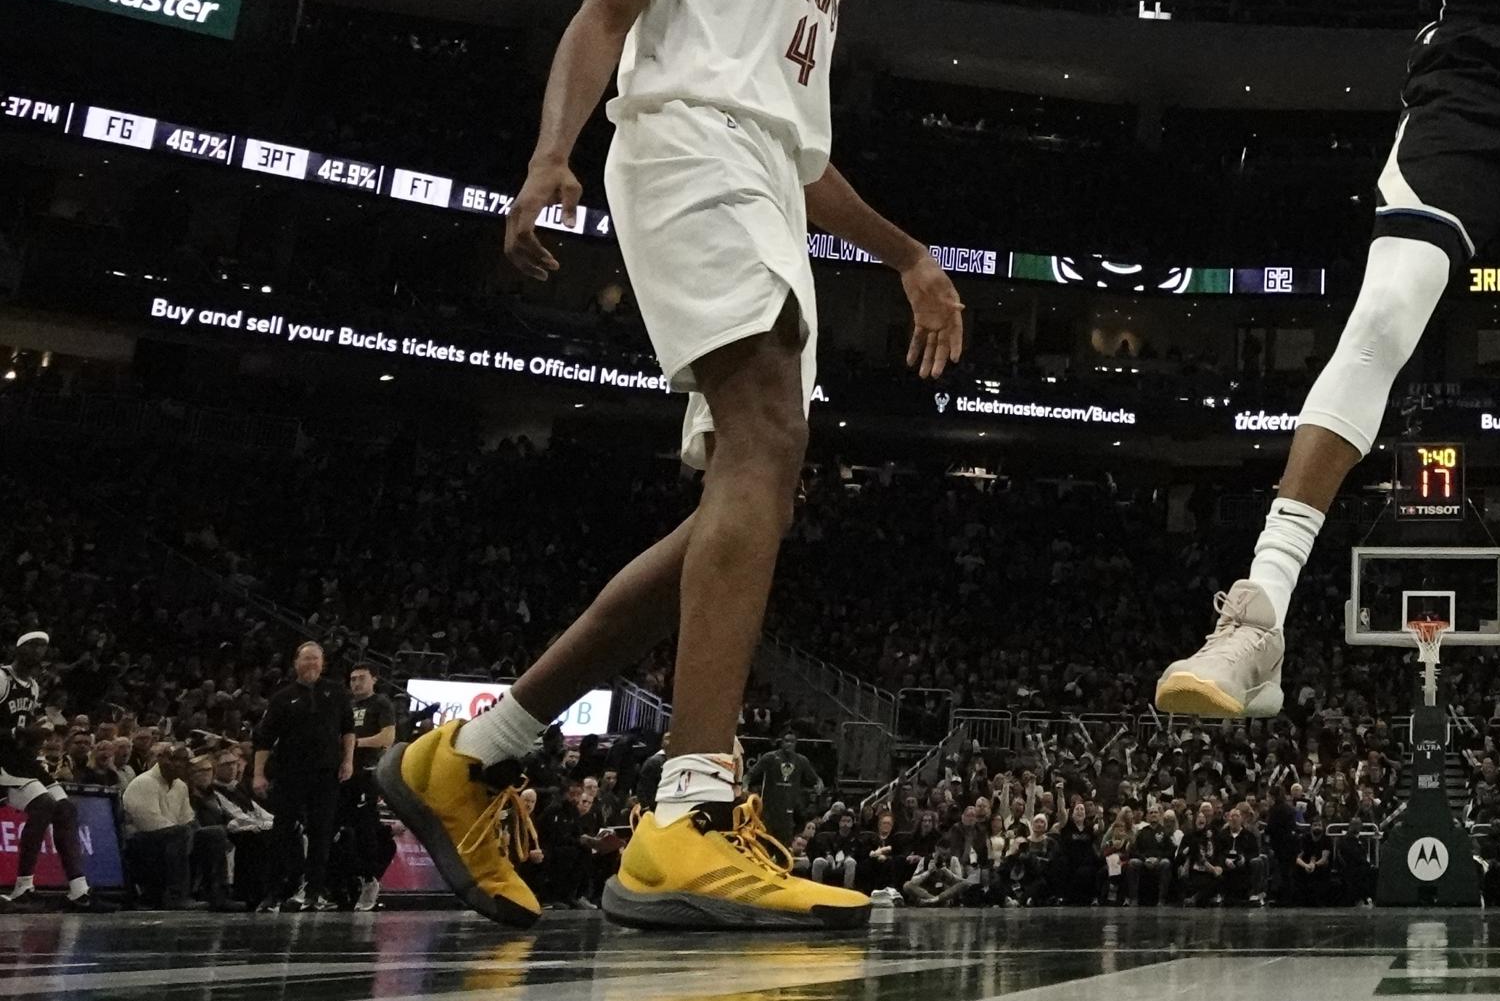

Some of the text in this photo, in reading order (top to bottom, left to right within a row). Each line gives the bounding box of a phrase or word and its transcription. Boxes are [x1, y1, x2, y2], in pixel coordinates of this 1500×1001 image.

[784, 14, 818, 87] 4
[32, 102, 59, 123] PM
[104, 116, 137, 140] FG
[166, 129, 227, 159] 46.7%
[256, 146, 297, 173] 3PT
[318, 160, 376, 188] 42.9%
[408, 176, 434, 199] FT
[462, 186, 515, 217] 66.7%
[597, 216, 609, 234] 4
[929, 245, 997, 275] BUCKS
[1263, 266, 1293, 293] 62
[151, 298, 194, 324] Buy
[199, 311, 242, 328] and
[247, 316, 283, 334] sell
[288, 324, 334, 342] your
[339, 327, 397, 352] Bucks
[403, 338, 465, 362] tickets
[470, 350, 490, 366] at
[495, 352, 524, 371] the
[530, 357, 596, 382] Official
[957, 397, 1135, 424] ticketmaster.com/Bucks
[1417, 448, 1456, 468] 7:40
[1422, 468, 1450, 498] 17
[1415, 505, 1461, 515] TISSOT
